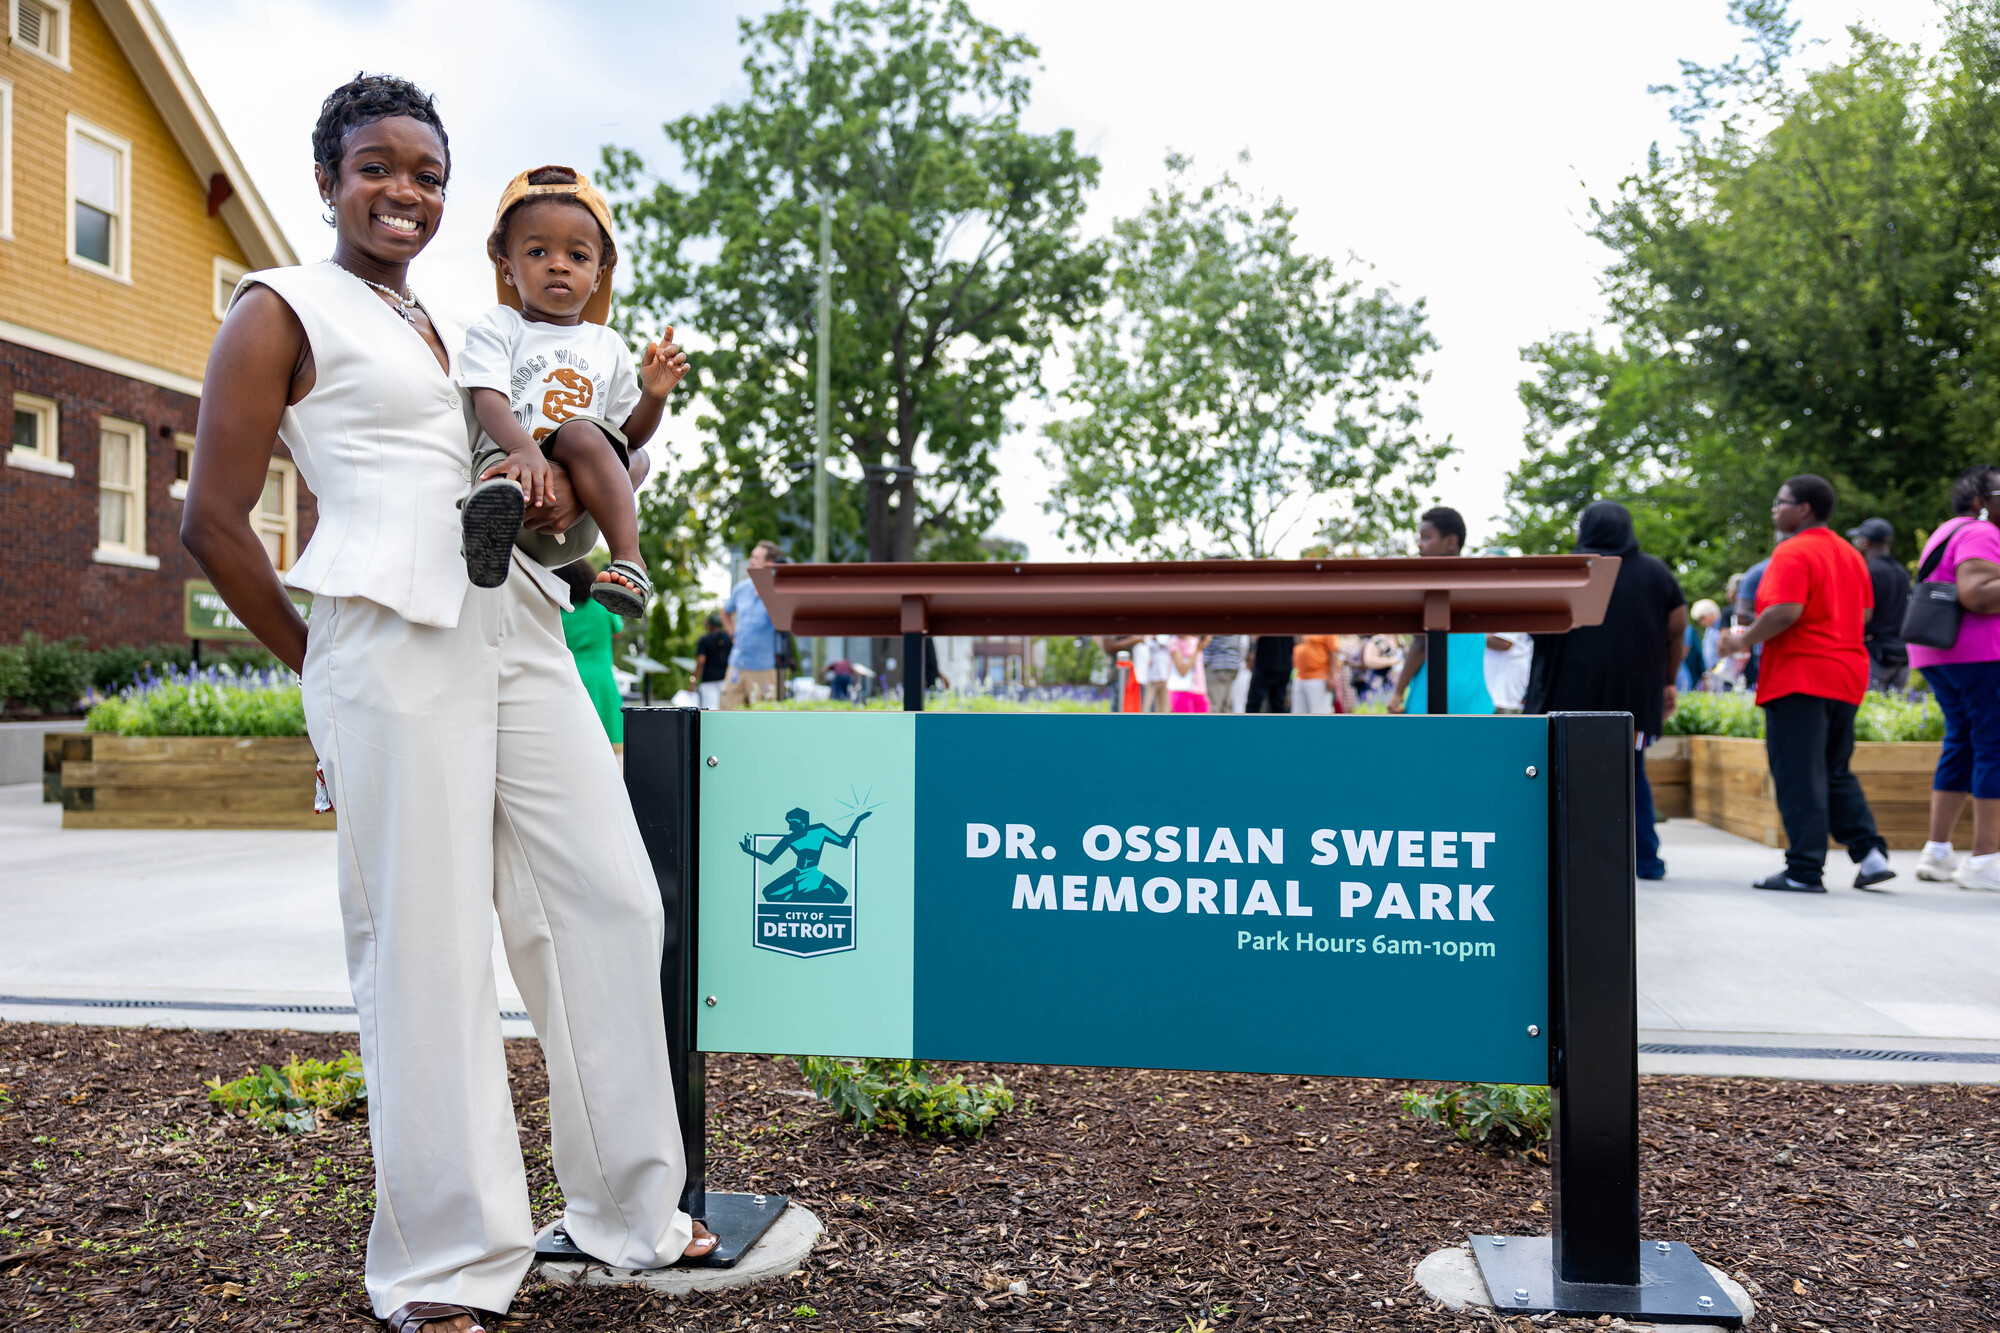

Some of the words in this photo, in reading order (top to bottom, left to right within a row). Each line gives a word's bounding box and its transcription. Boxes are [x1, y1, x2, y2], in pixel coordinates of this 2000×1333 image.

[554, 349, 589, 371] WILD
[967, 823, 1057, 860] DR.
[1083, 825, 1284, 865] OSSIAN
[1311, 829, 1496, 868] SWEET
[1012, 873, 1313, 917] MEMORIAL
[1340, 882, 1496, 921] PARK
[785, 911, 808, 920] CITY
[810, 912, 824, 920] OF
[763, 922, 846, 939] DETROIT
[1237, 930, 1290, 951] Park
[1296, 932, 1367, 953] Hours
[1373, 935, 1496, 961] 6am-10pm
